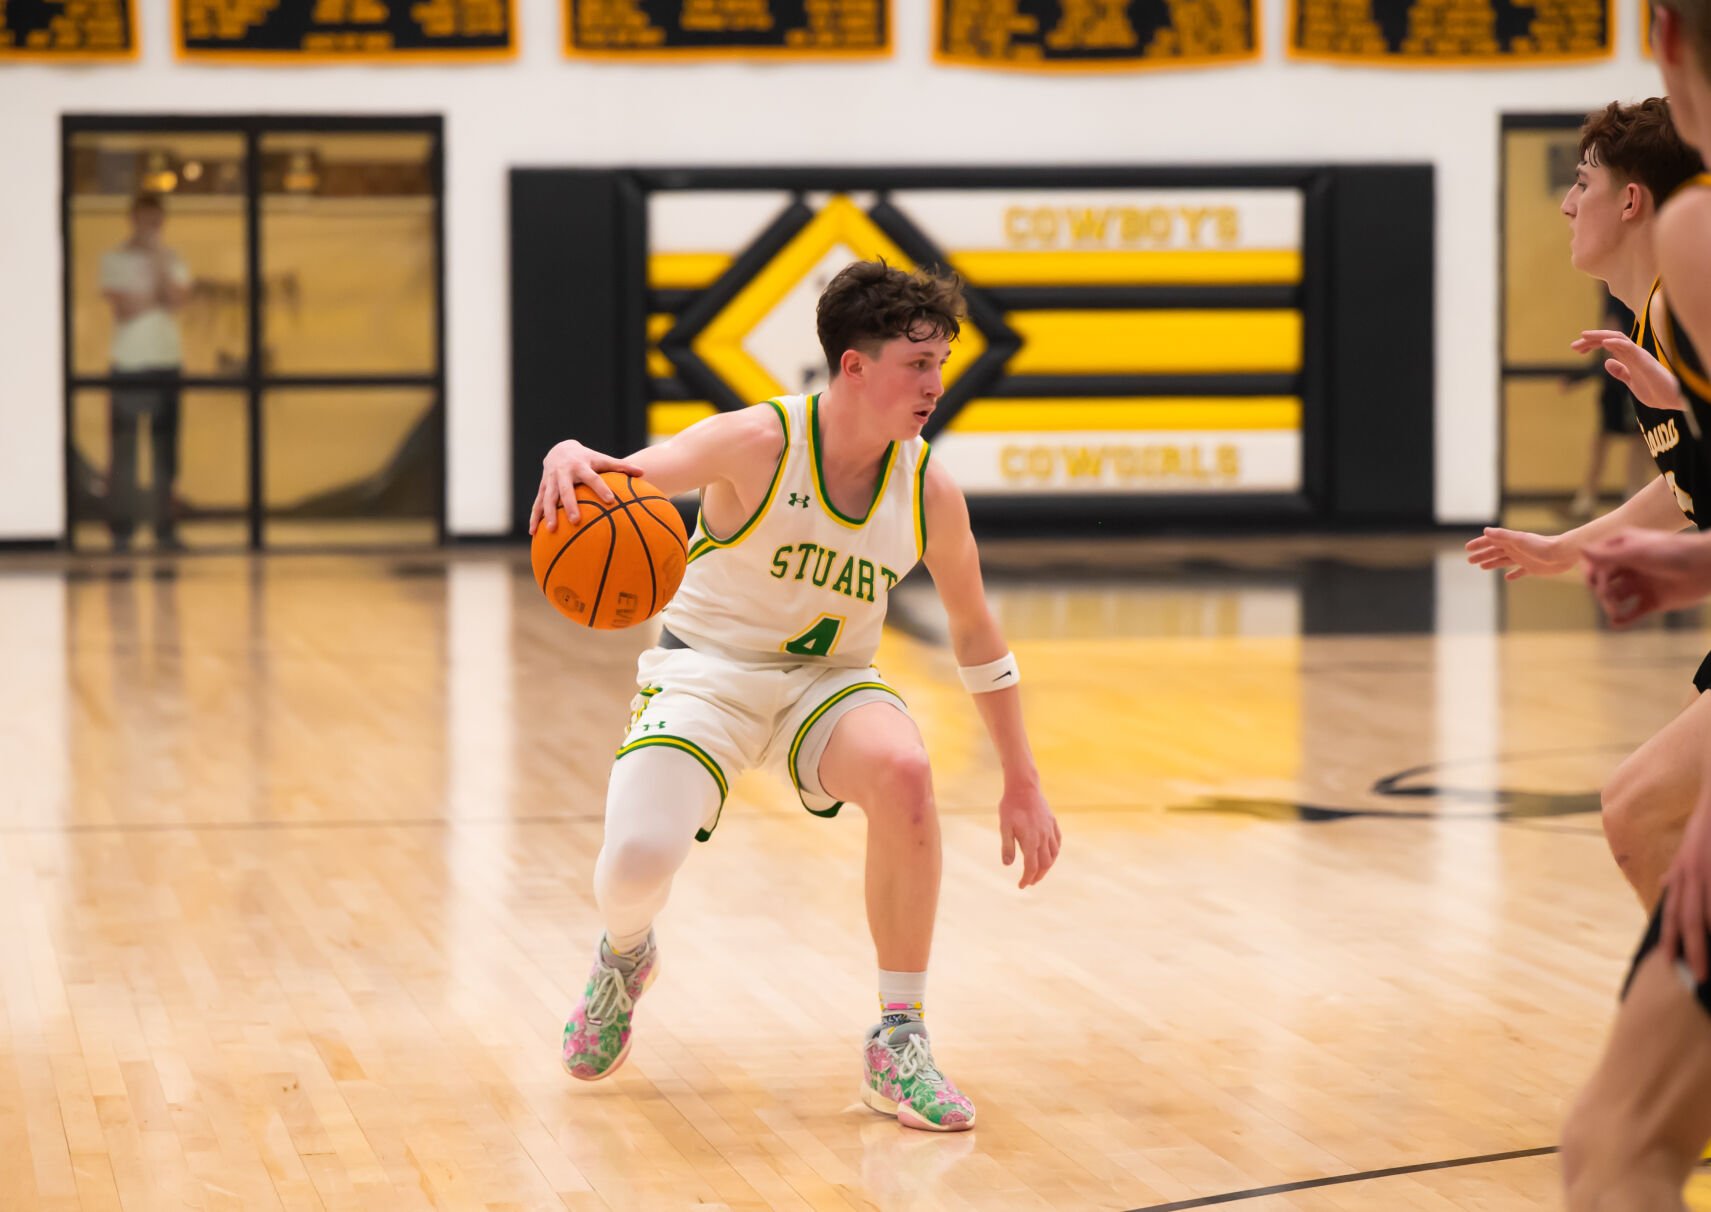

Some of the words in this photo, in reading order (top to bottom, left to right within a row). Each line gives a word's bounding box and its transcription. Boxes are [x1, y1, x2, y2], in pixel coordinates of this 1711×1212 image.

[1003, 206, 1240, 243] COWBOYS
[1000, 445, 1240, 480] COWGIRLS
[769, 542, 899, 604] STUART
[779, 611, 847, 658] 4
